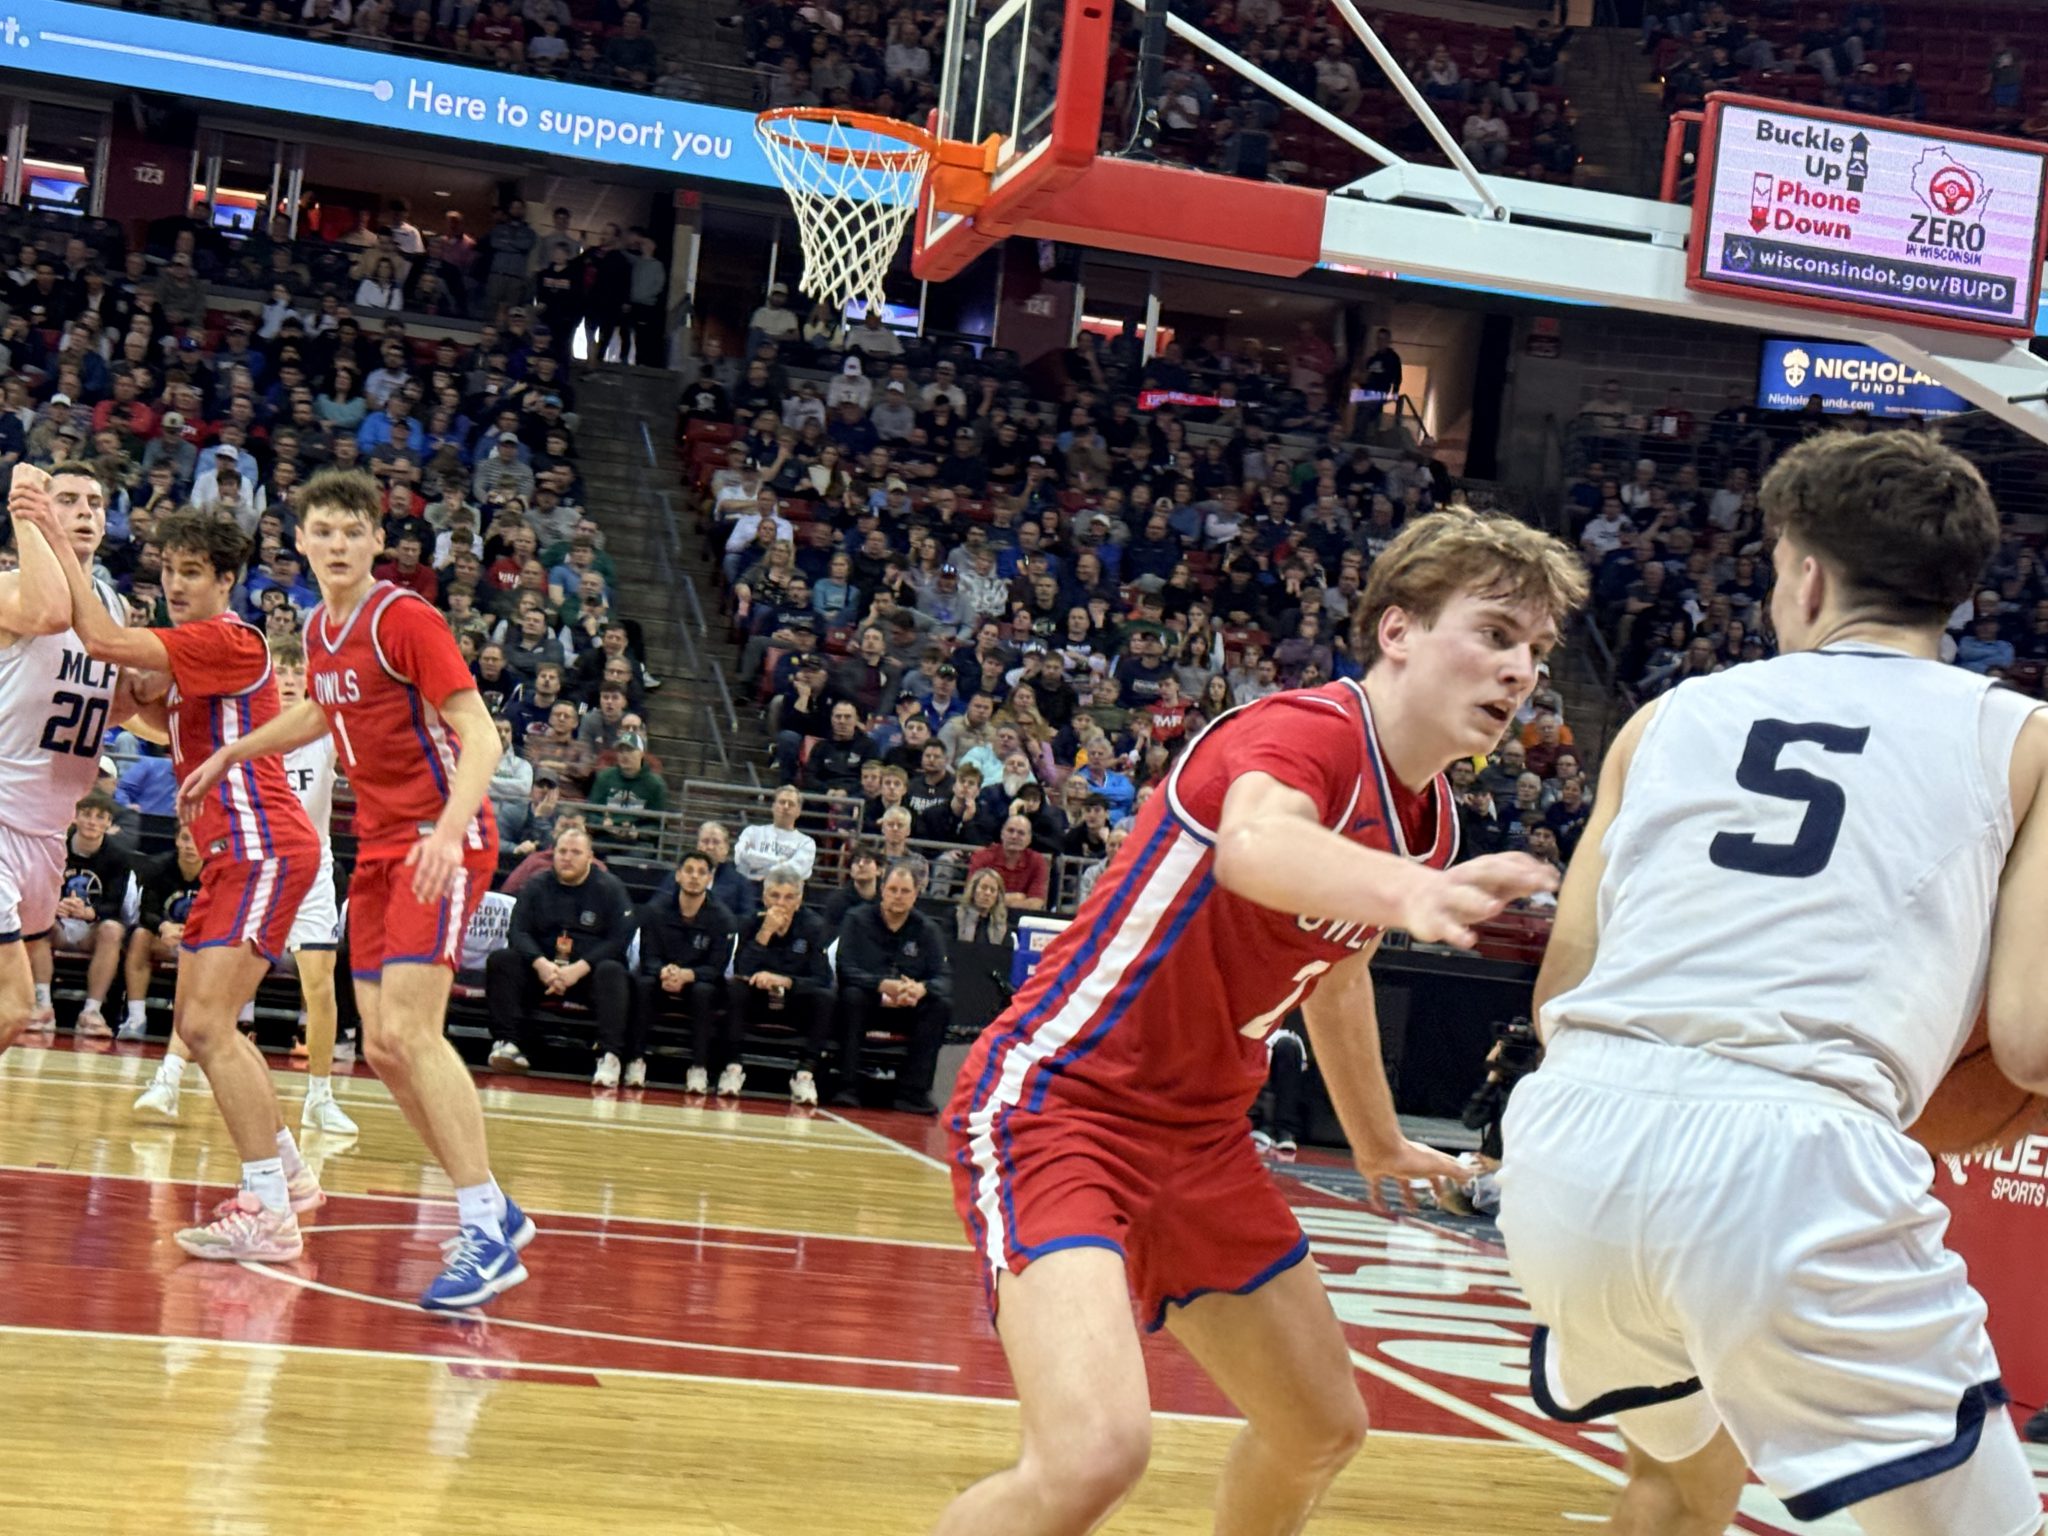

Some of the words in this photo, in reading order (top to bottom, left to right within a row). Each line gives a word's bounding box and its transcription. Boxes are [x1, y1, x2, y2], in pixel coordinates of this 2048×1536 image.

[0, 16, 30, 48] t.
[407, 78, 487, 121] Here
[497, 97, 528, 128] to
[538, 110, 665, 149] support
[671, 129, 733, 161] you
[1756, 119, 1845, 153] Buckle
[1805, 155, 1842, 185] Up
[133, 166, 165, 185] 123
[1776, 180, 1861, 215] Phone
[1774, 208, 1852, 240] Down
[1907, 213, 1986, 252] ZERO
[1906, 243, 1917, 256] IN
[1920, 244, 1982, 265] WISCONSIN
[1760, 250, 2007, 301] wisconsindot.gov/BUPD
[1814, 357, 1942, 387] NICHOLA
[1850, 381, 1906, 396] FUNDS
[1768, 393, 1875, 411] Nicholaunds.com
[56, 648, 117, 689] MCF
[314, 668, 361, 706] OWLS
[39, 690, 109, 759] 20
[334, 710, 357, 768] 1
[1709, 717, 1871, 878] 5
[468, 916, 496, 928] IKE
[1297, 914, 1387, 950] OWL
[1991, 1177, 2045, 1207] SPORTS
